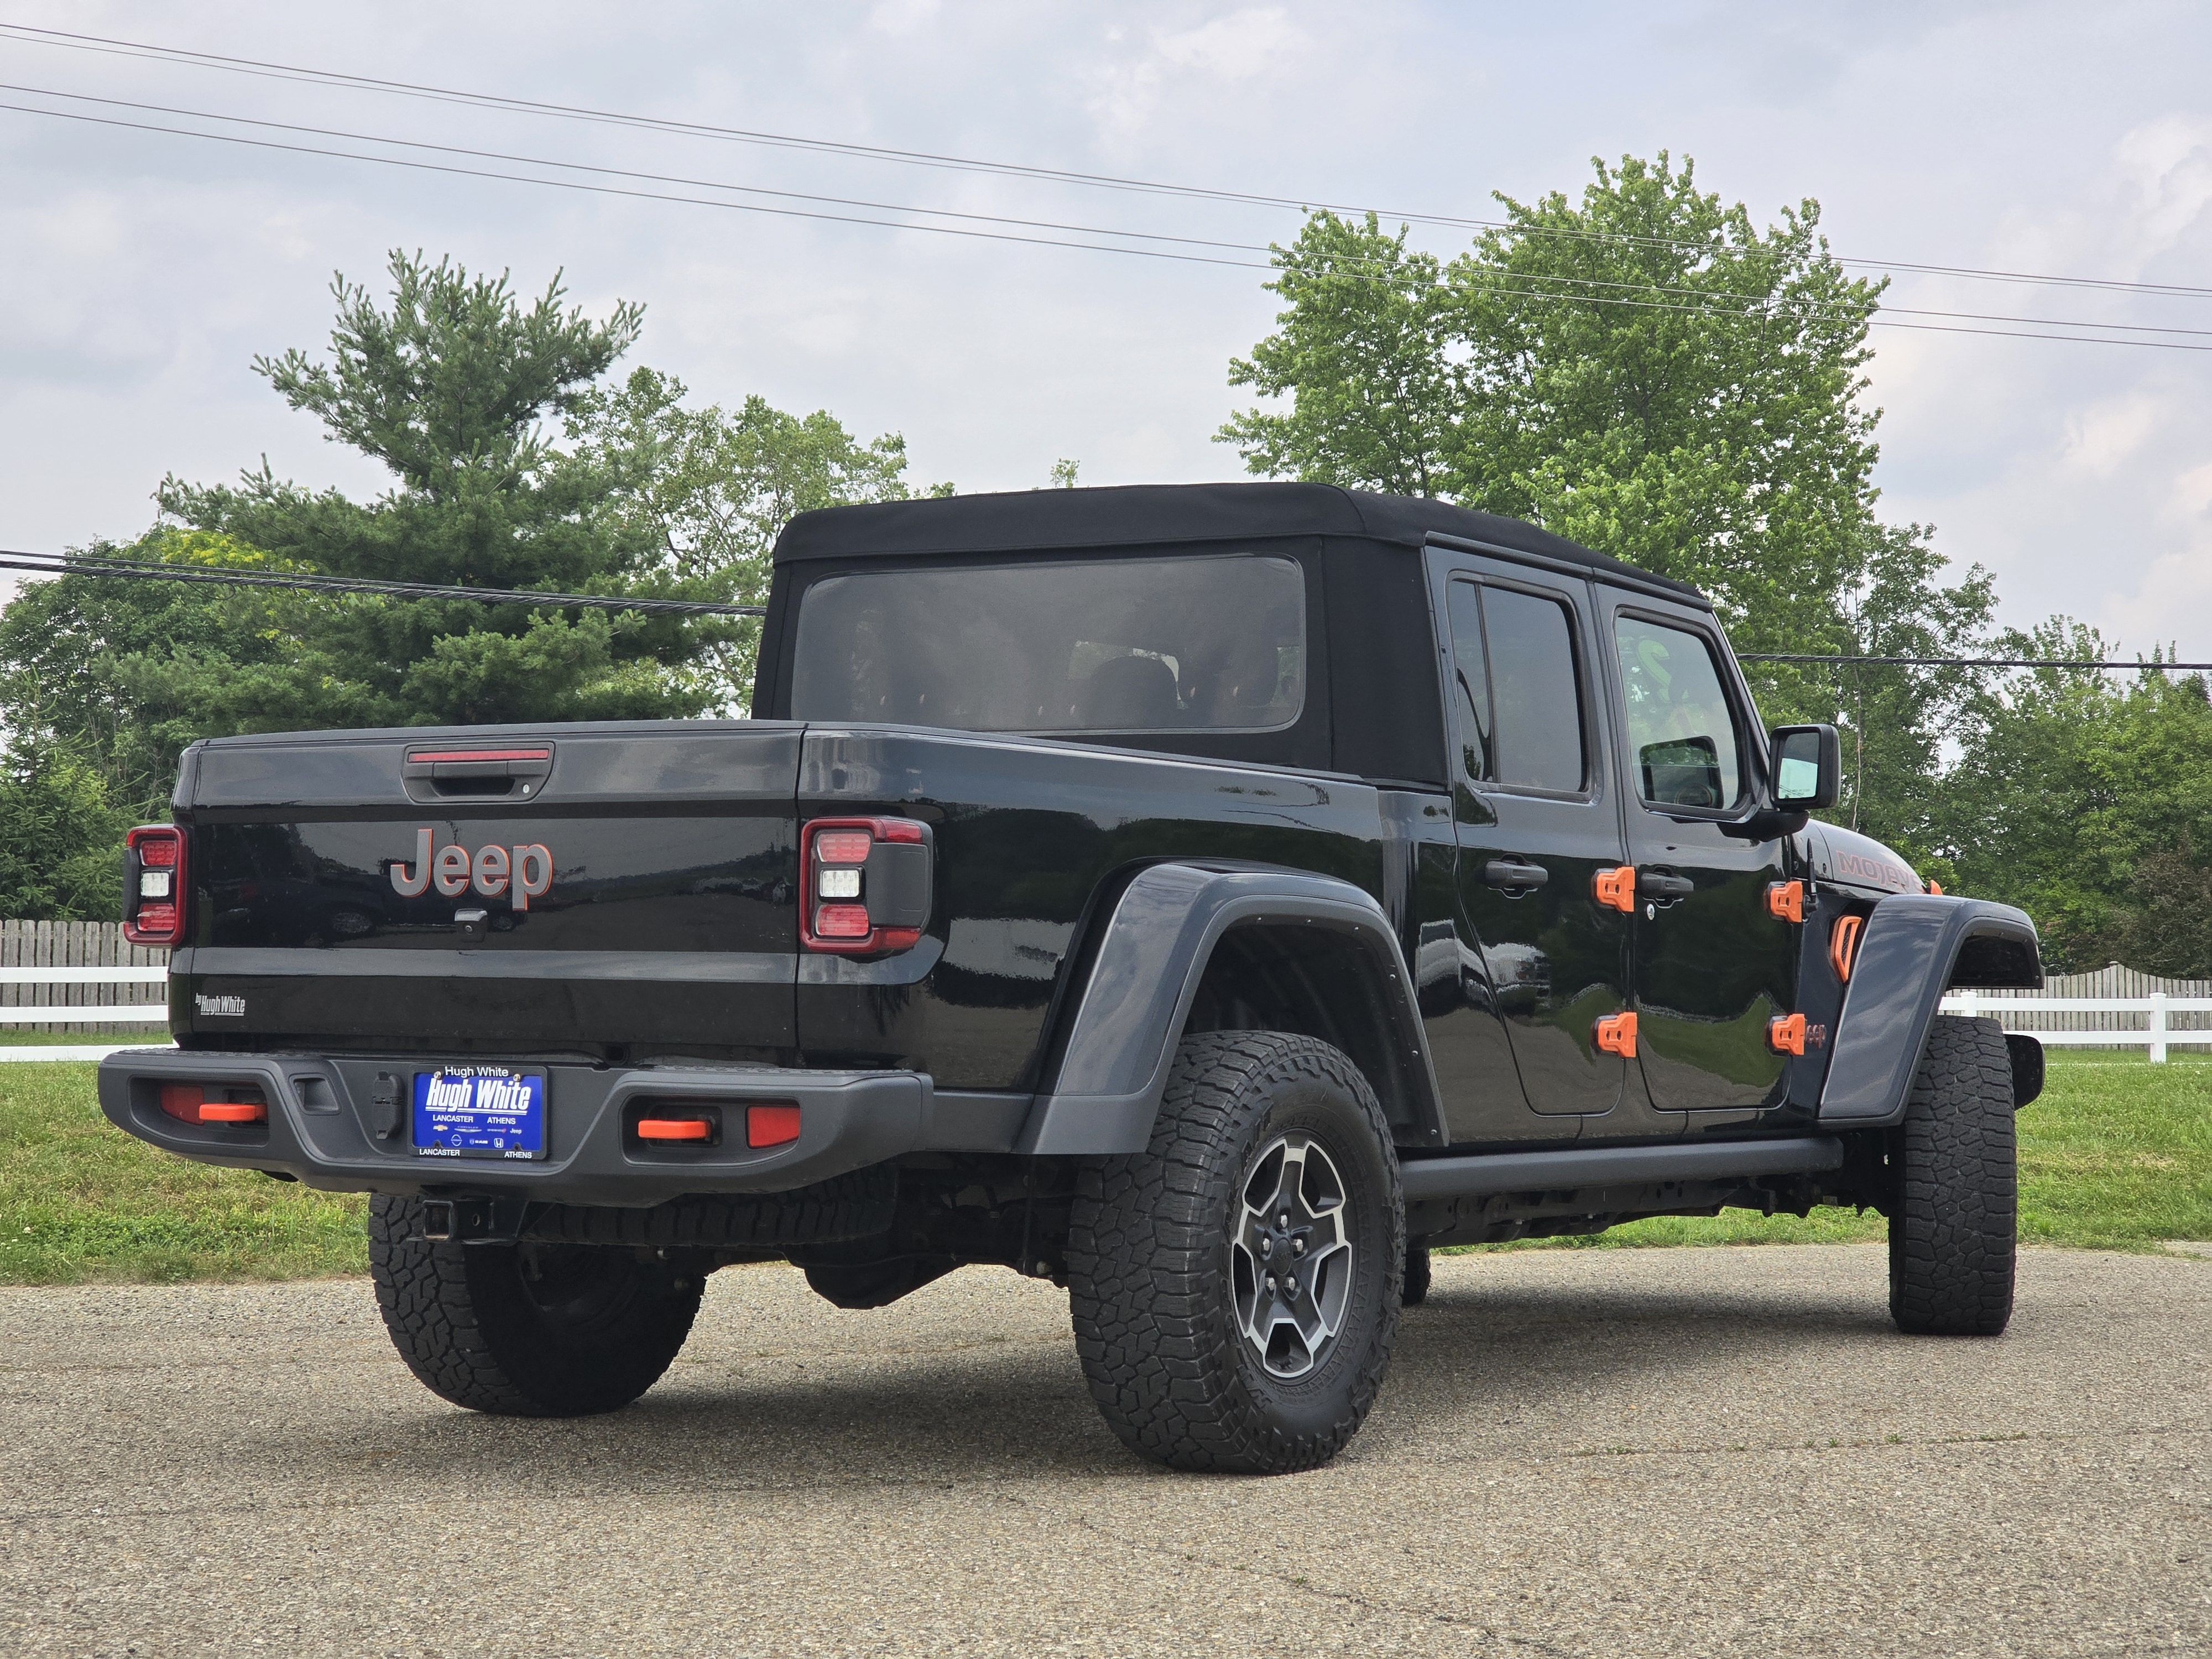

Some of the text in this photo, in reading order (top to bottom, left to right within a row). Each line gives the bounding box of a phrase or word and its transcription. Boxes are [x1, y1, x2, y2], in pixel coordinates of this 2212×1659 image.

[390, 827, 553, 911] Jeep
[201, 995, 221, 1015] Hugh
[221, 996, 246, 1013] White
[445, 1066, 509, 1078] Hugh White
[426, 1078, 531, 1112] Hugh White
[432, 1114, 516, 1125] LANCASTER ATHENS
[419, 1148, 460, 1156] LANCASTER
[504, 1151, 533, 1159] ATHENS
